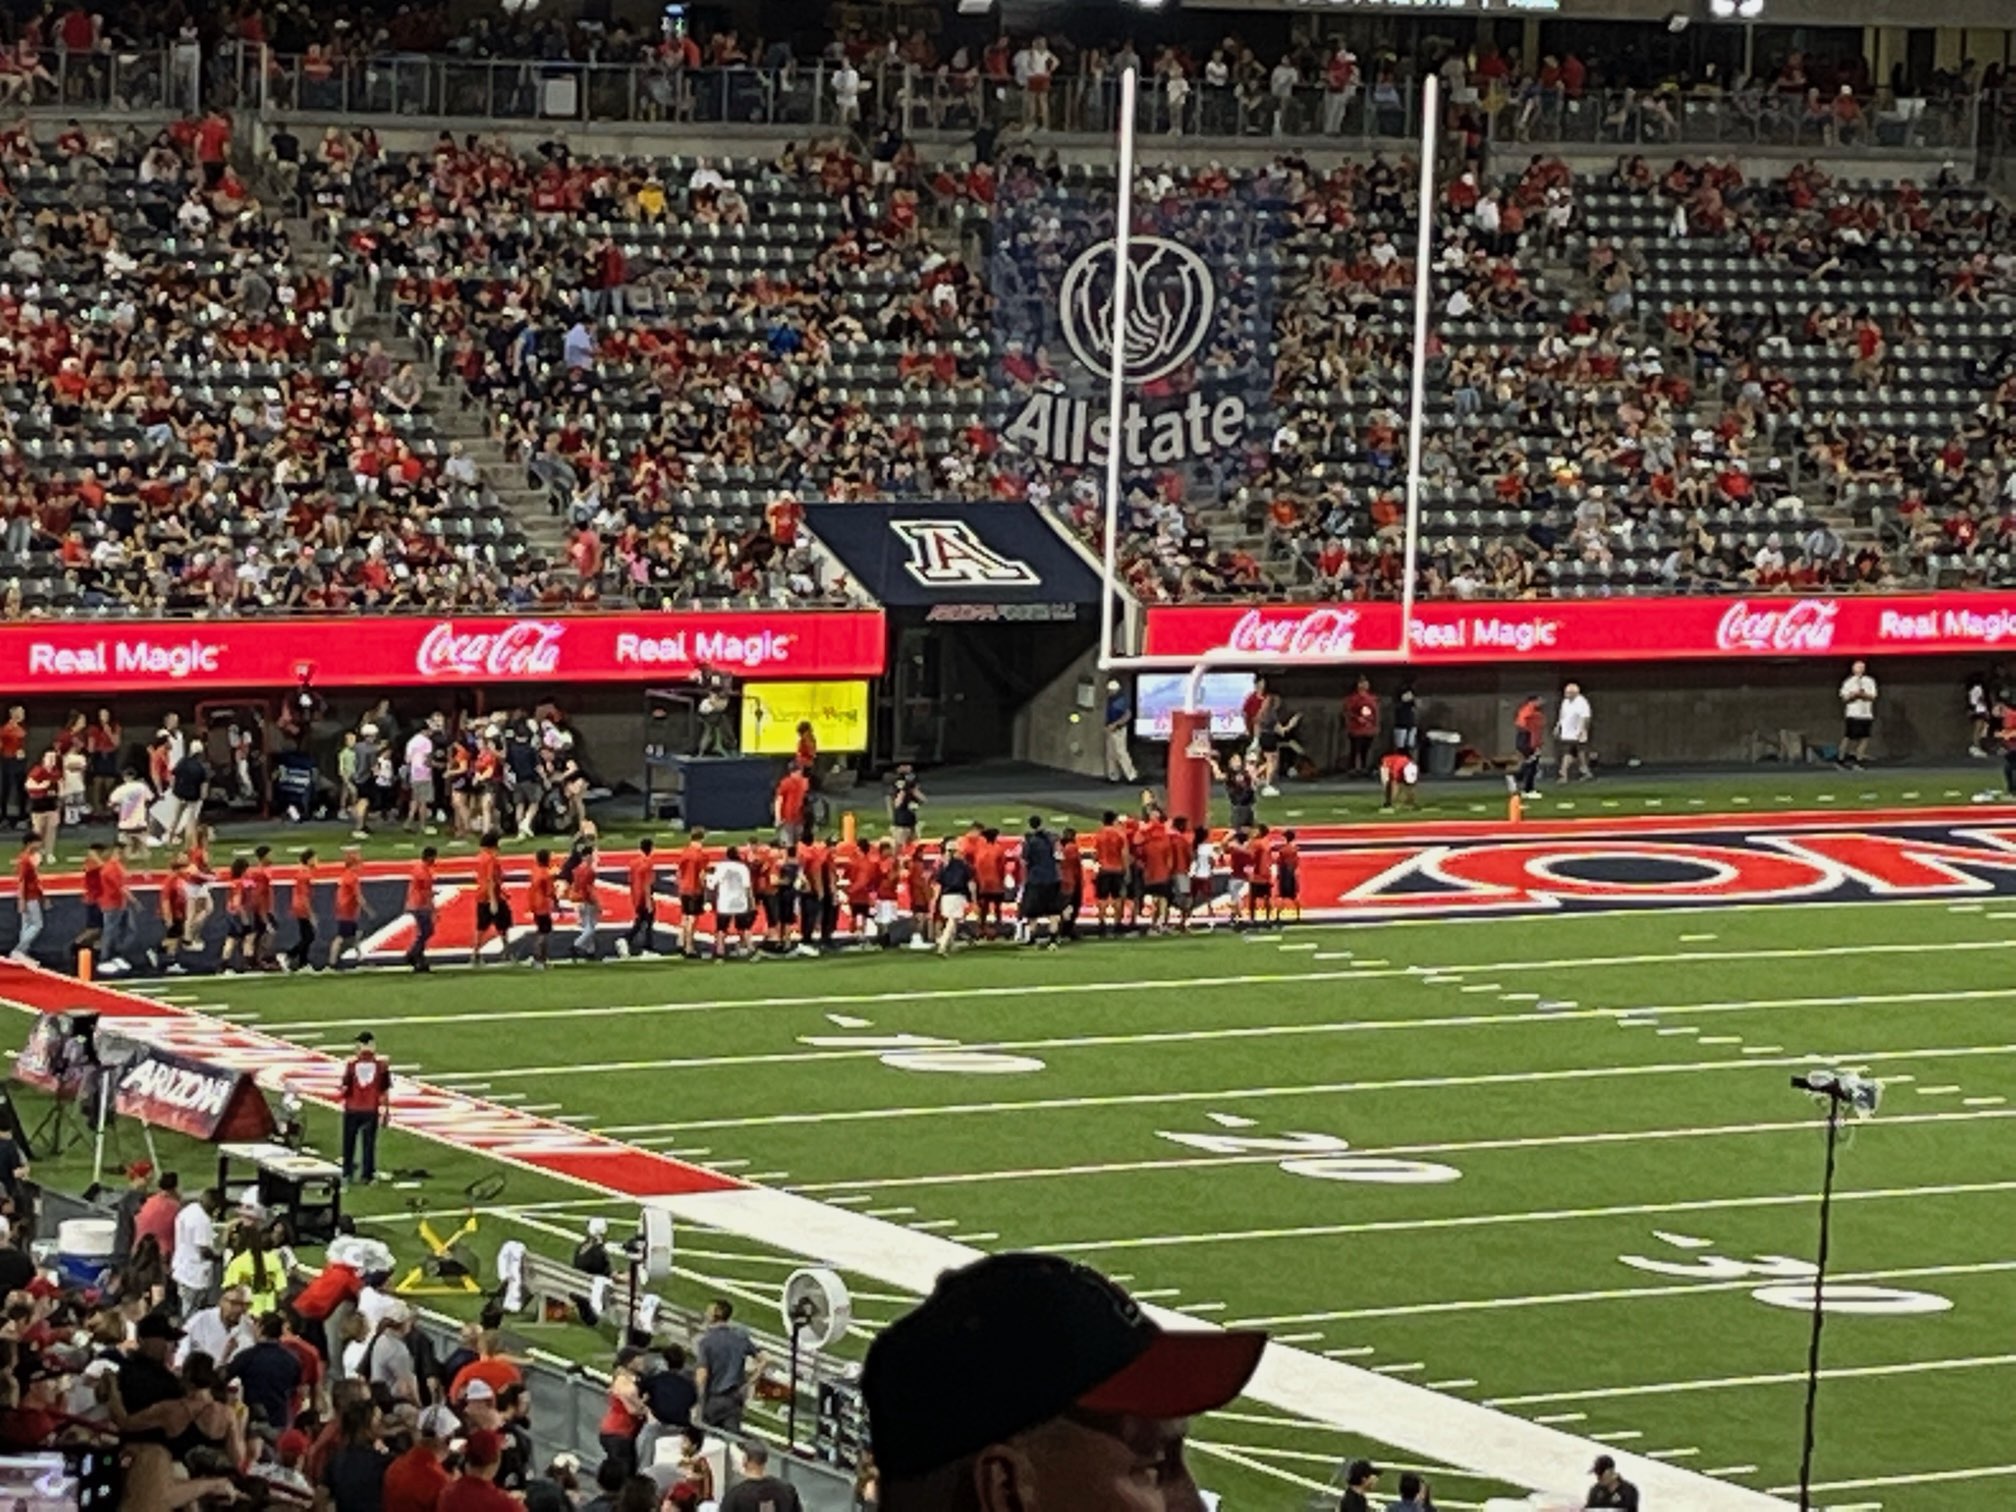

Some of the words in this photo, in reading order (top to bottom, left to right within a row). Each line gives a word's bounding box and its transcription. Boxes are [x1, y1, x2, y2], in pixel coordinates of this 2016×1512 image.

[1003, 391, 1246, 467] Allstate
[889, 519, 1042, 587] A
[416, 619, 567, 677] Coca-Cola
[616, 630, 688, 663] Real
[695, 629, 790, 667] Magic
[1229, 607, 1361, 655] Coca-Cola
[1408, 617, 1466, 649] Real
[1472, 616, 1558, 652] Magic
[1716, 599, 1839, 651] Coca-Cola
[1878, 609, 1941, 640] Real
[29, 641, 107, 675] Real
[115, 639, 220, 678] Magic
